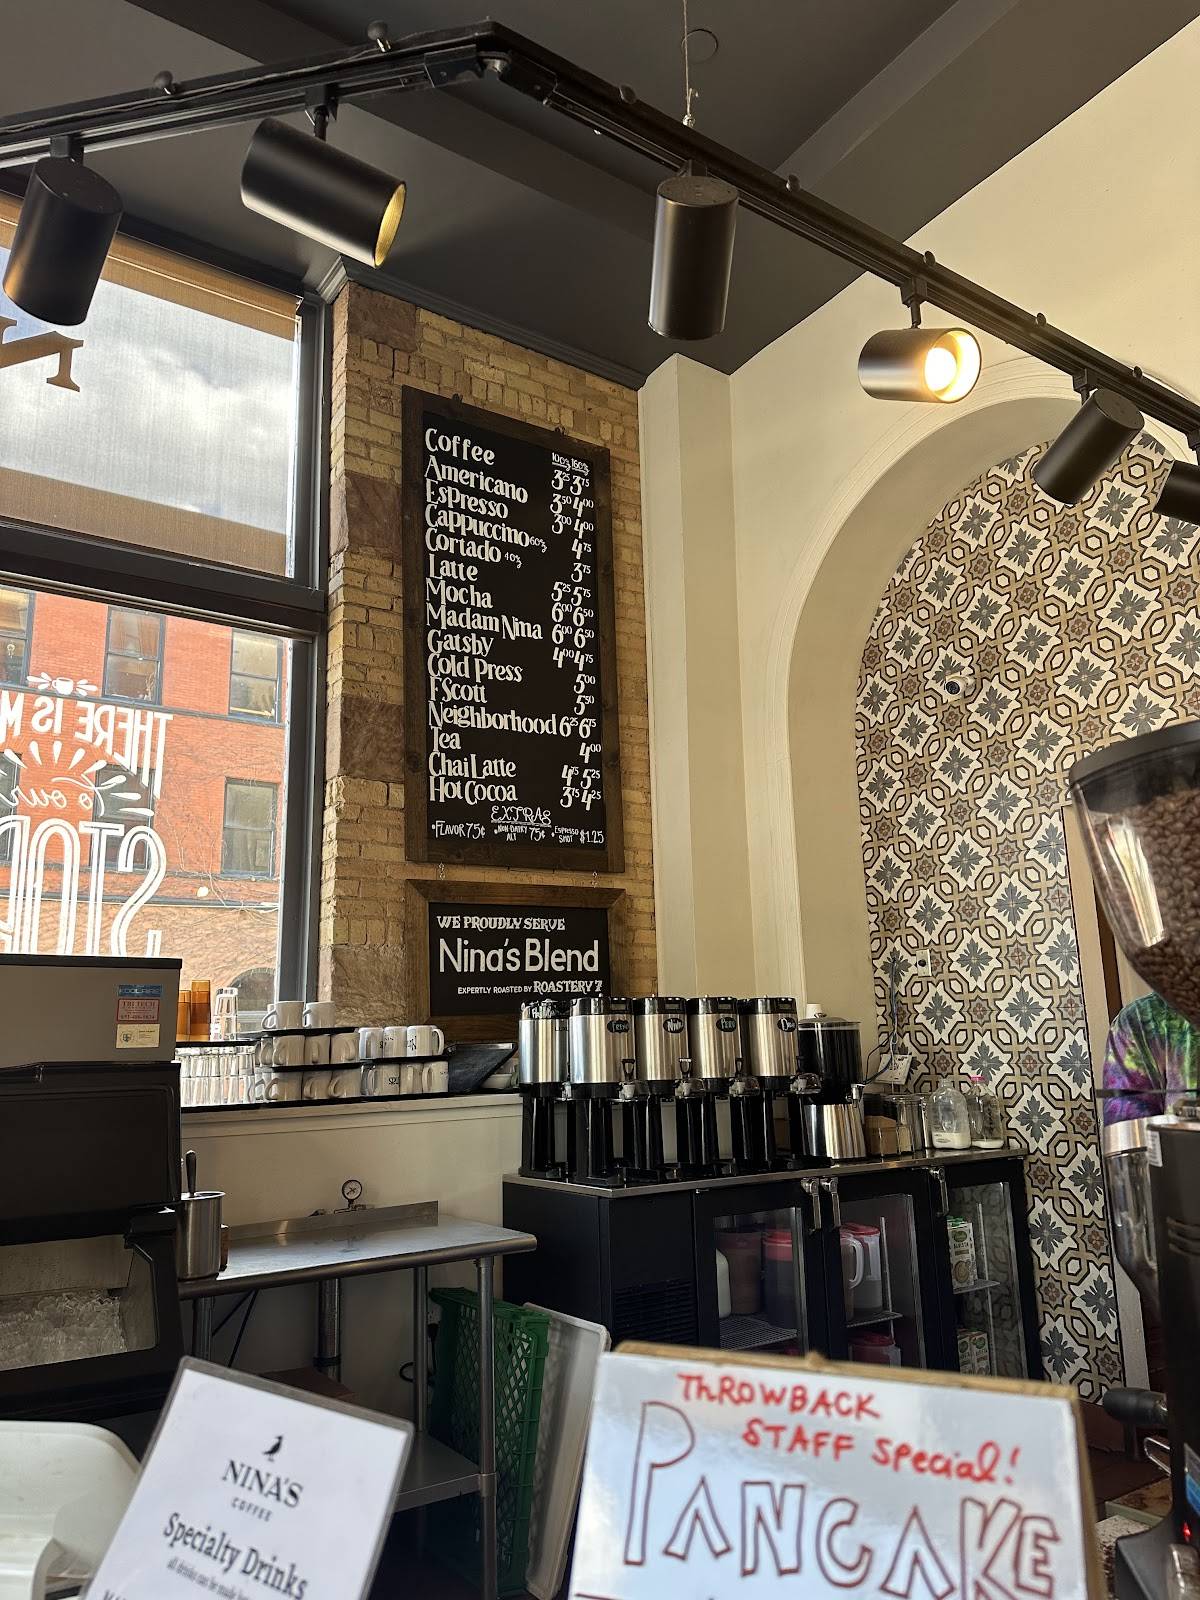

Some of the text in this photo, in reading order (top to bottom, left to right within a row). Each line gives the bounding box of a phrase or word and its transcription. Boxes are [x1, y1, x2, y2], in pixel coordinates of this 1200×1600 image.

[425, 428, 495, 465] Coffee
[424, 455, 528, 503] Americano
[425, 478, 509, 519] Espresso
[425, 504, 529, 547] Cappuccino
[425, 528, 501, 562] Cortado
[429, 554, 478, 581] Latte
[425, 577, 494, 608] Mocha
[426, 602, 500, 632] Madam
[501, 615, 543, 640] Nina
[427, 629, 494, 657] Gatsby
[427, 653, 471, 678] Cold
[474, 658, 523, 683] Press
[428, 700, 557, 735] Neighborhood
[430, 726, 461, 751] Tea
[428, 751, 469, 778] Chai
[470, 753, 517, 779] Latte
[429, 776, 463, 802] Hot
[464, 780, 518, 805] Cocoa
[491, 805, 552, 826] EXTRAS
[437, 915, 566, 932] WE PROUDLY SERVE
[439, 938, 599, 973] Nina's Blend
[457, 986, 492, 995] EXPERTLY
[493, 985, 523, 994] ROASTED
[523, 985, 533, 993] BY
[533, 980, 593, 995] ROASTERY
[741, 1419, 854, 1462] STAFF
[221, 1459, 304, 1508] NINA'S
[623, 1401, 1060, 1600] PANCAKE
[231, 1497, 273, 1522] COFFEE
[163, 1512, 309, 1600] Specialty Drinks
